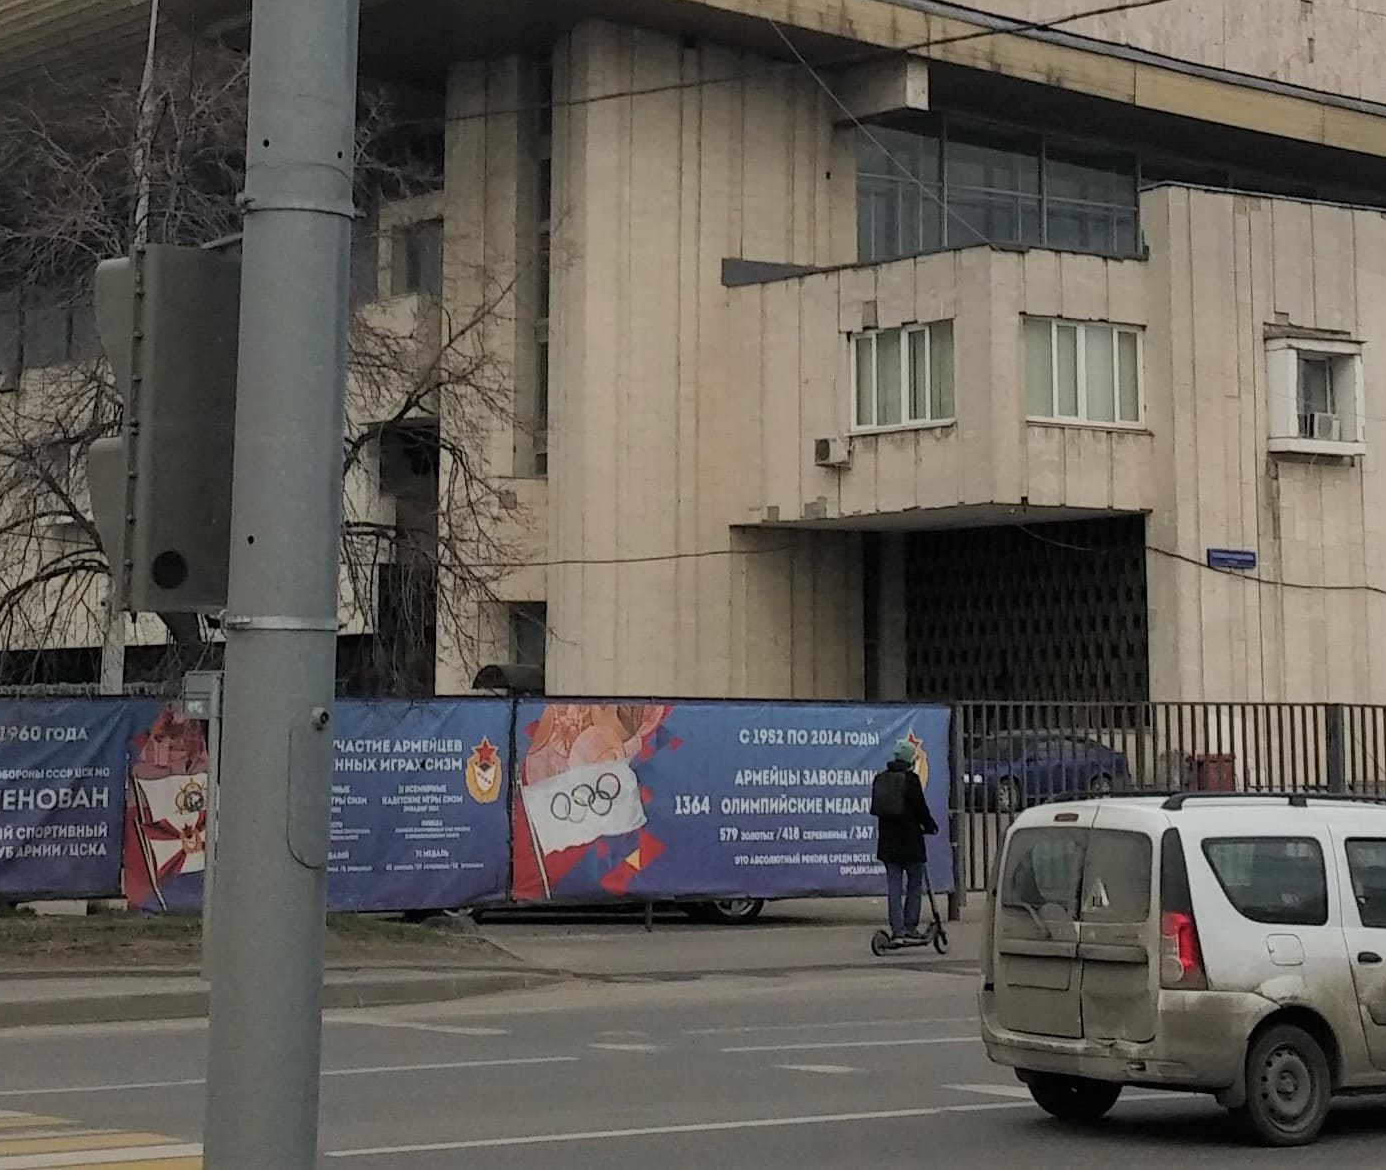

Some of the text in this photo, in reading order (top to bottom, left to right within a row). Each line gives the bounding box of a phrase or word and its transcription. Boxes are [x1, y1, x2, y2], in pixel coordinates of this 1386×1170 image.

[45, 726, 89, 743] ГОДА
[739, 729, 880, 747] С 1952 ПО 2014 ГОДЫ
[393, 737, 463, 753] АРМЕЙЦЕВ
[333, 757, 463, 772] ННЫХ ИГРАХ СИЗМ
[46, 768, 73, 779] СССР
[734, 765, 801, 787] АРМЕЙЦЫ
[674, 794, 872, 815] 1364 ОЛИМПИЙСКИЕ МЕДАЛ
[15, 822, 108, 840] СПОРТИВНЫЙ
[719, 827, 739, 841] 579
[14, 843, 61, 859] АРМИИ
